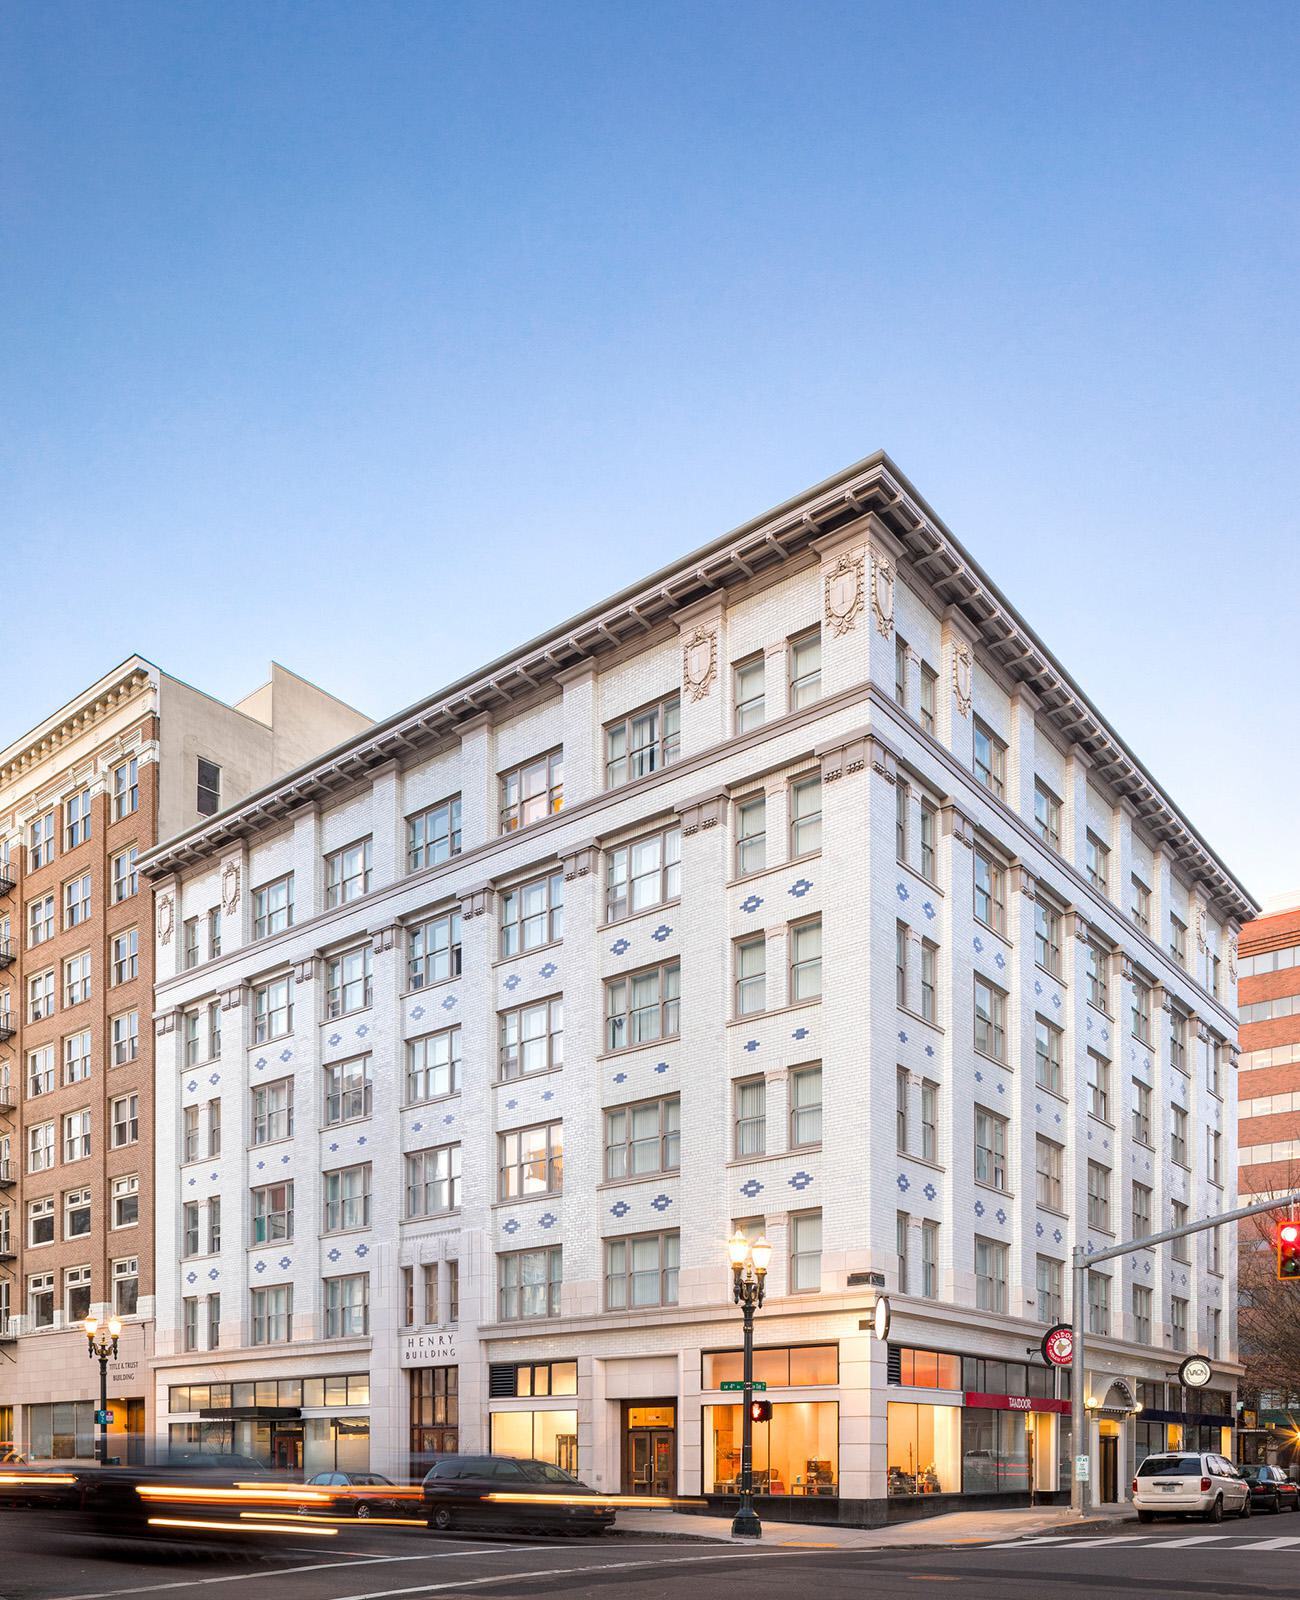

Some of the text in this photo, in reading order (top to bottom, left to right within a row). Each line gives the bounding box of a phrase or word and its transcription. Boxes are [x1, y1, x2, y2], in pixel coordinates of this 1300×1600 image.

[408, 1334, 454, 1348] HENRY
[405, 1348, 456, 1359] BUILDING
[113, 1373, 134, 1381] BUILDING
[1009, 1397, 1031, 1408] TANDOOR
